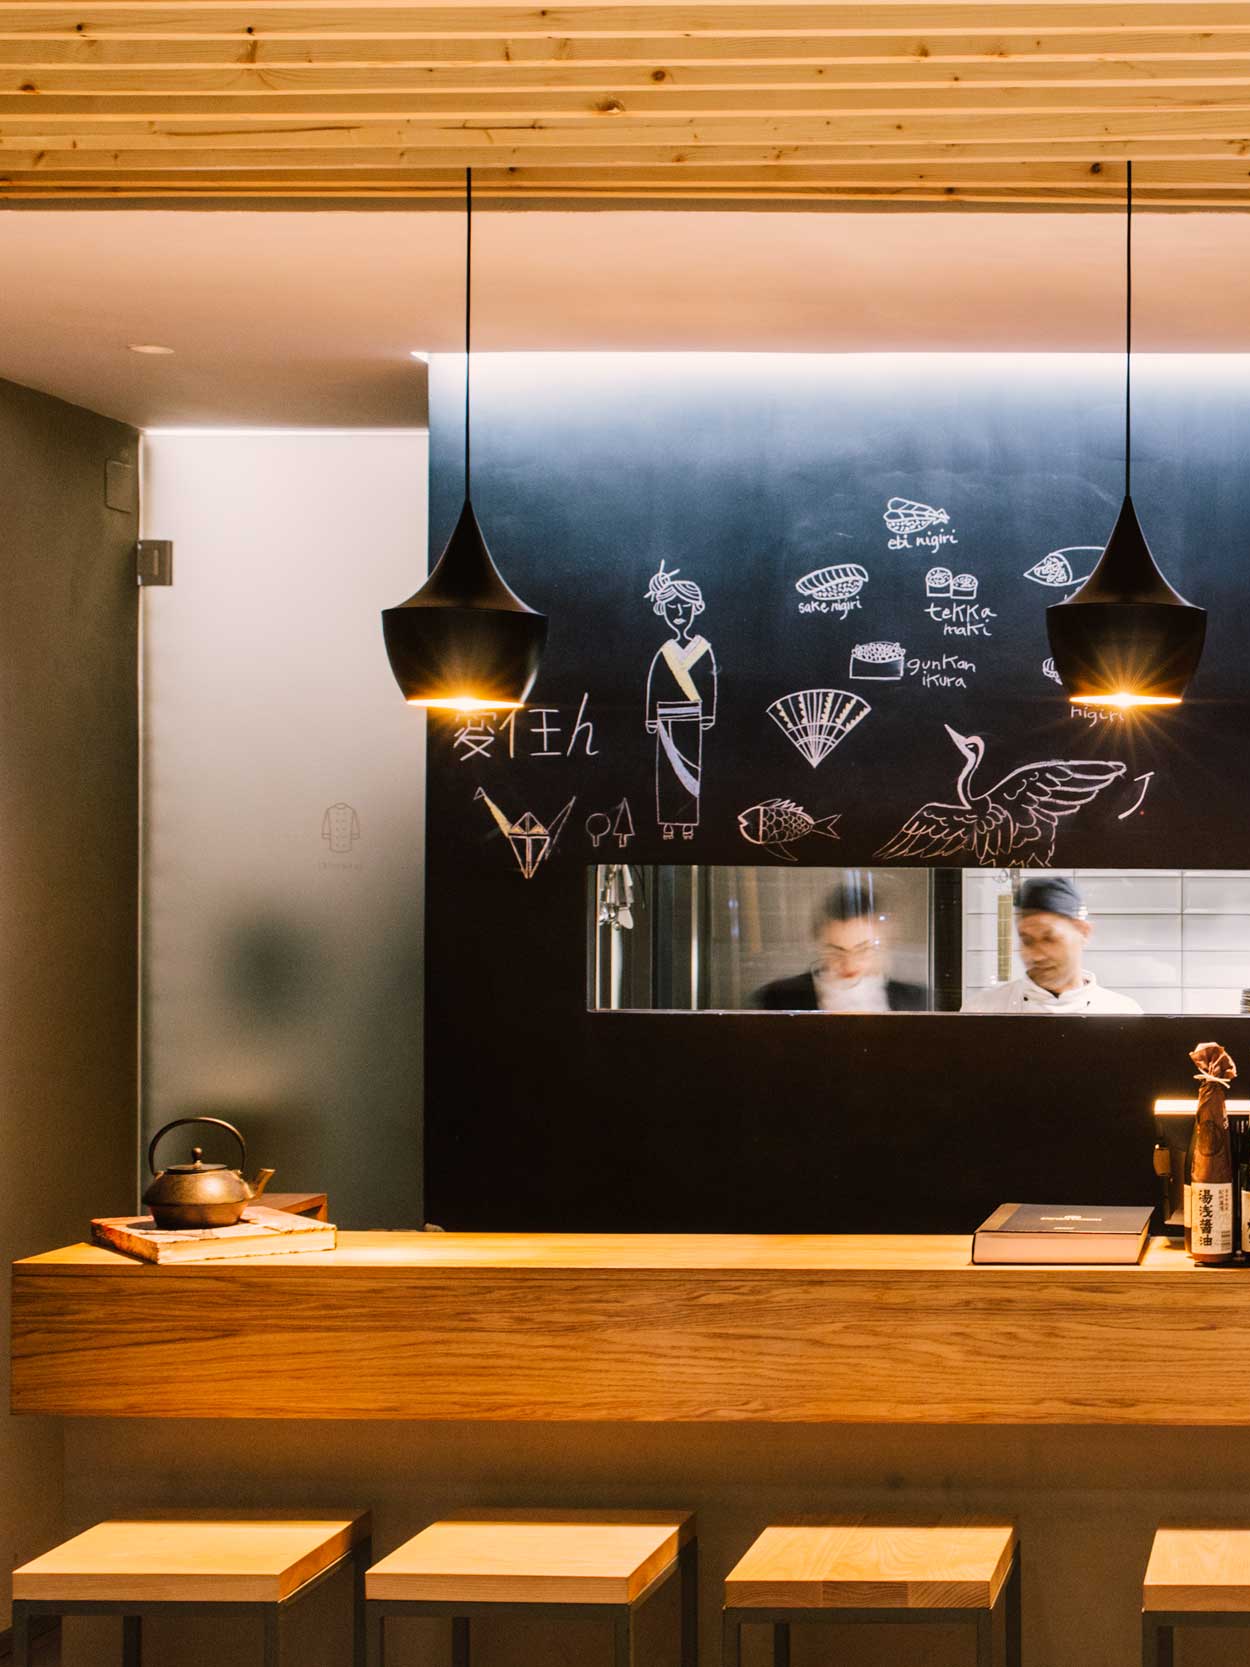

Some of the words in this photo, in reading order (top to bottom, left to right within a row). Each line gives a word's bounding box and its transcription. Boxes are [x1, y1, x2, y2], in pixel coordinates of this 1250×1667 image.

[887, 533, 912, 550] ebi
[916, 528, 958, 553] nigiri
[798, 600, 829, 614] sake
[831, 596, 863, 620] nigiri
